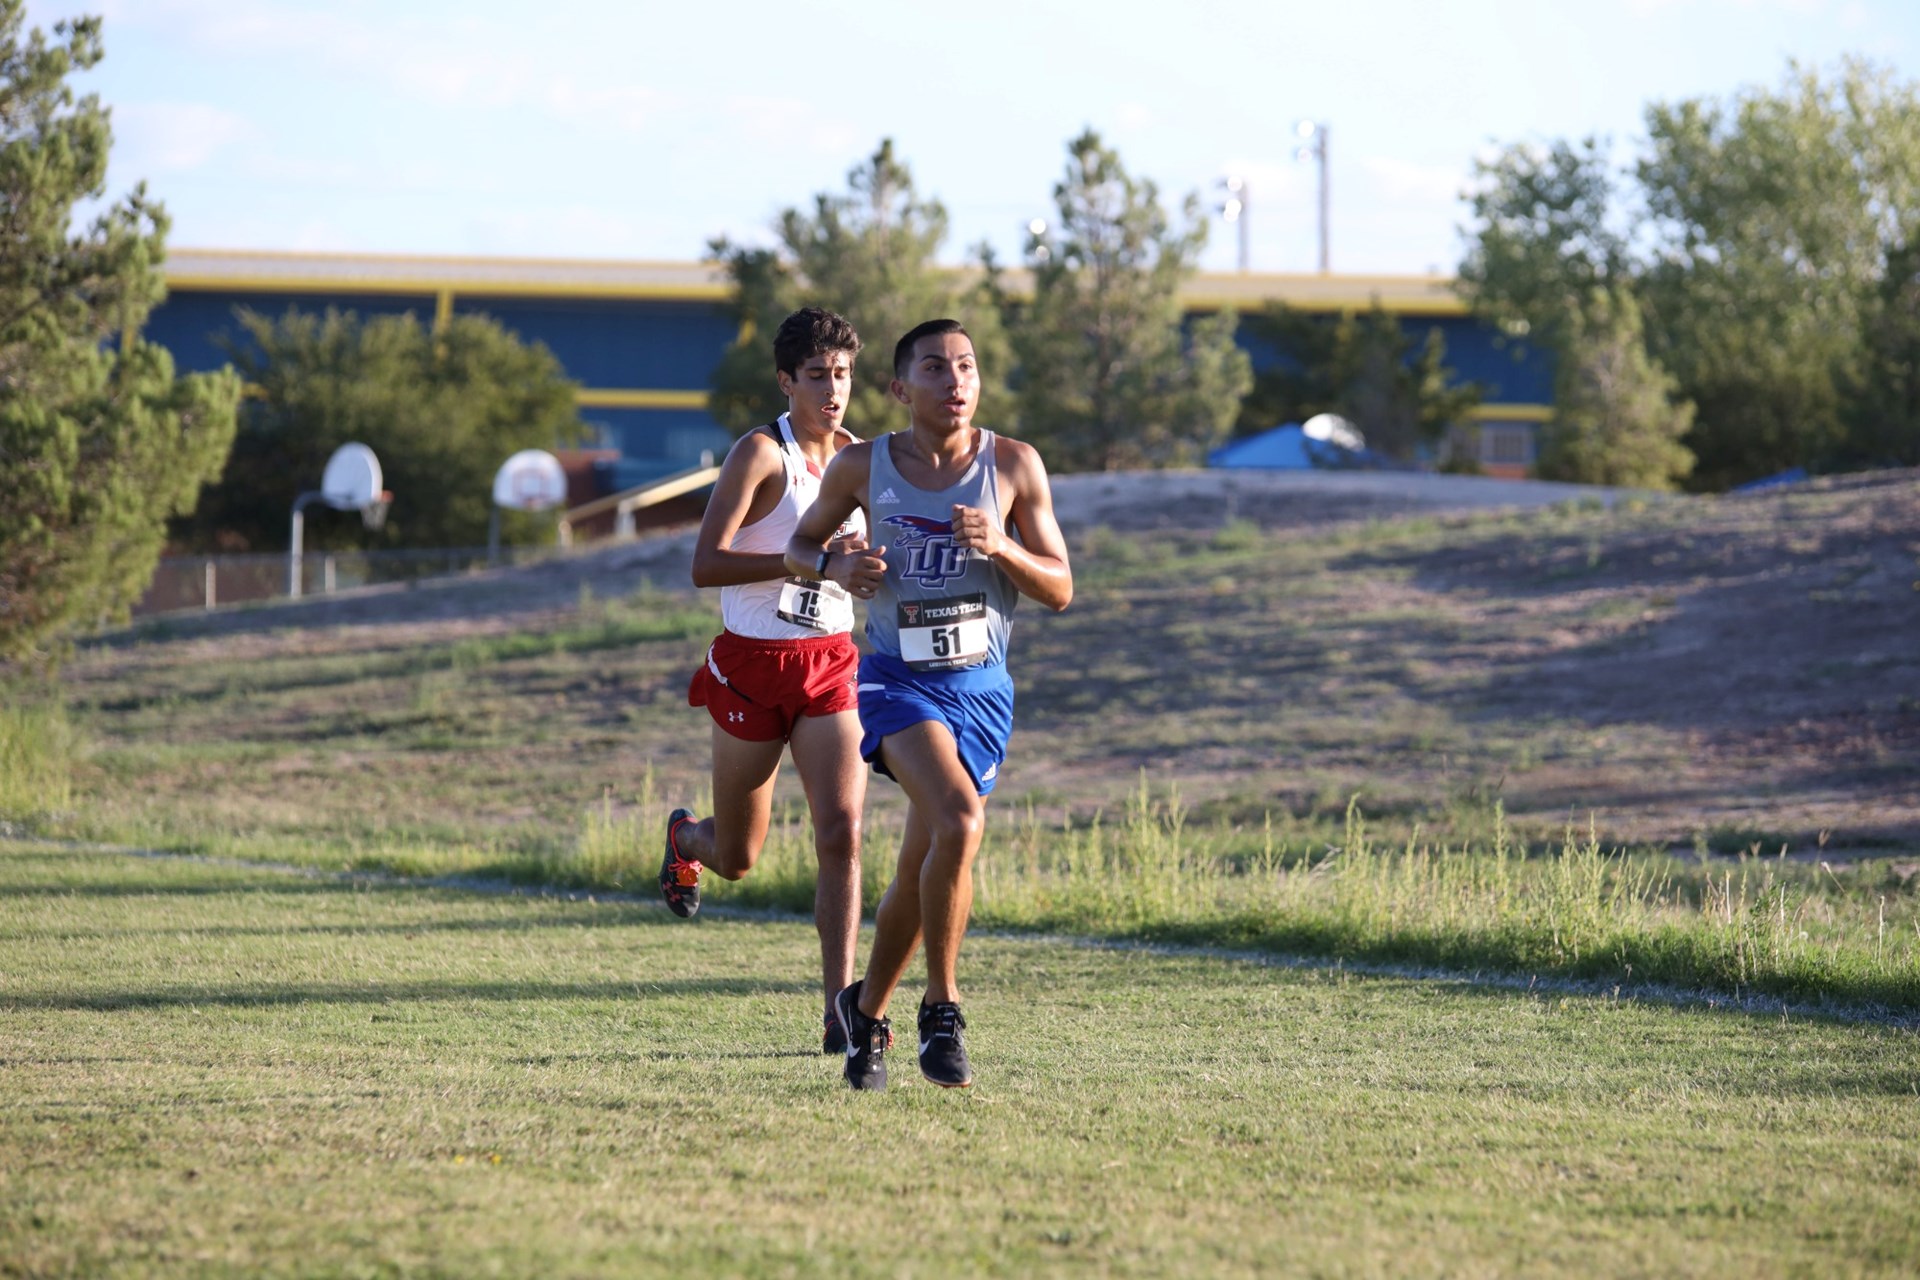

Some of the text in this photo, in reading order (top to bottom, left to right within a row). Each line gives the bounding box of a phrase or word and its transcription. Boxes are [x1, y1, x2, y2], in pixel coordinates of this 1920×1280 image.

[925, 602, 983, 619] TEXAS TECH
[932, 627, 961, 657] 51
